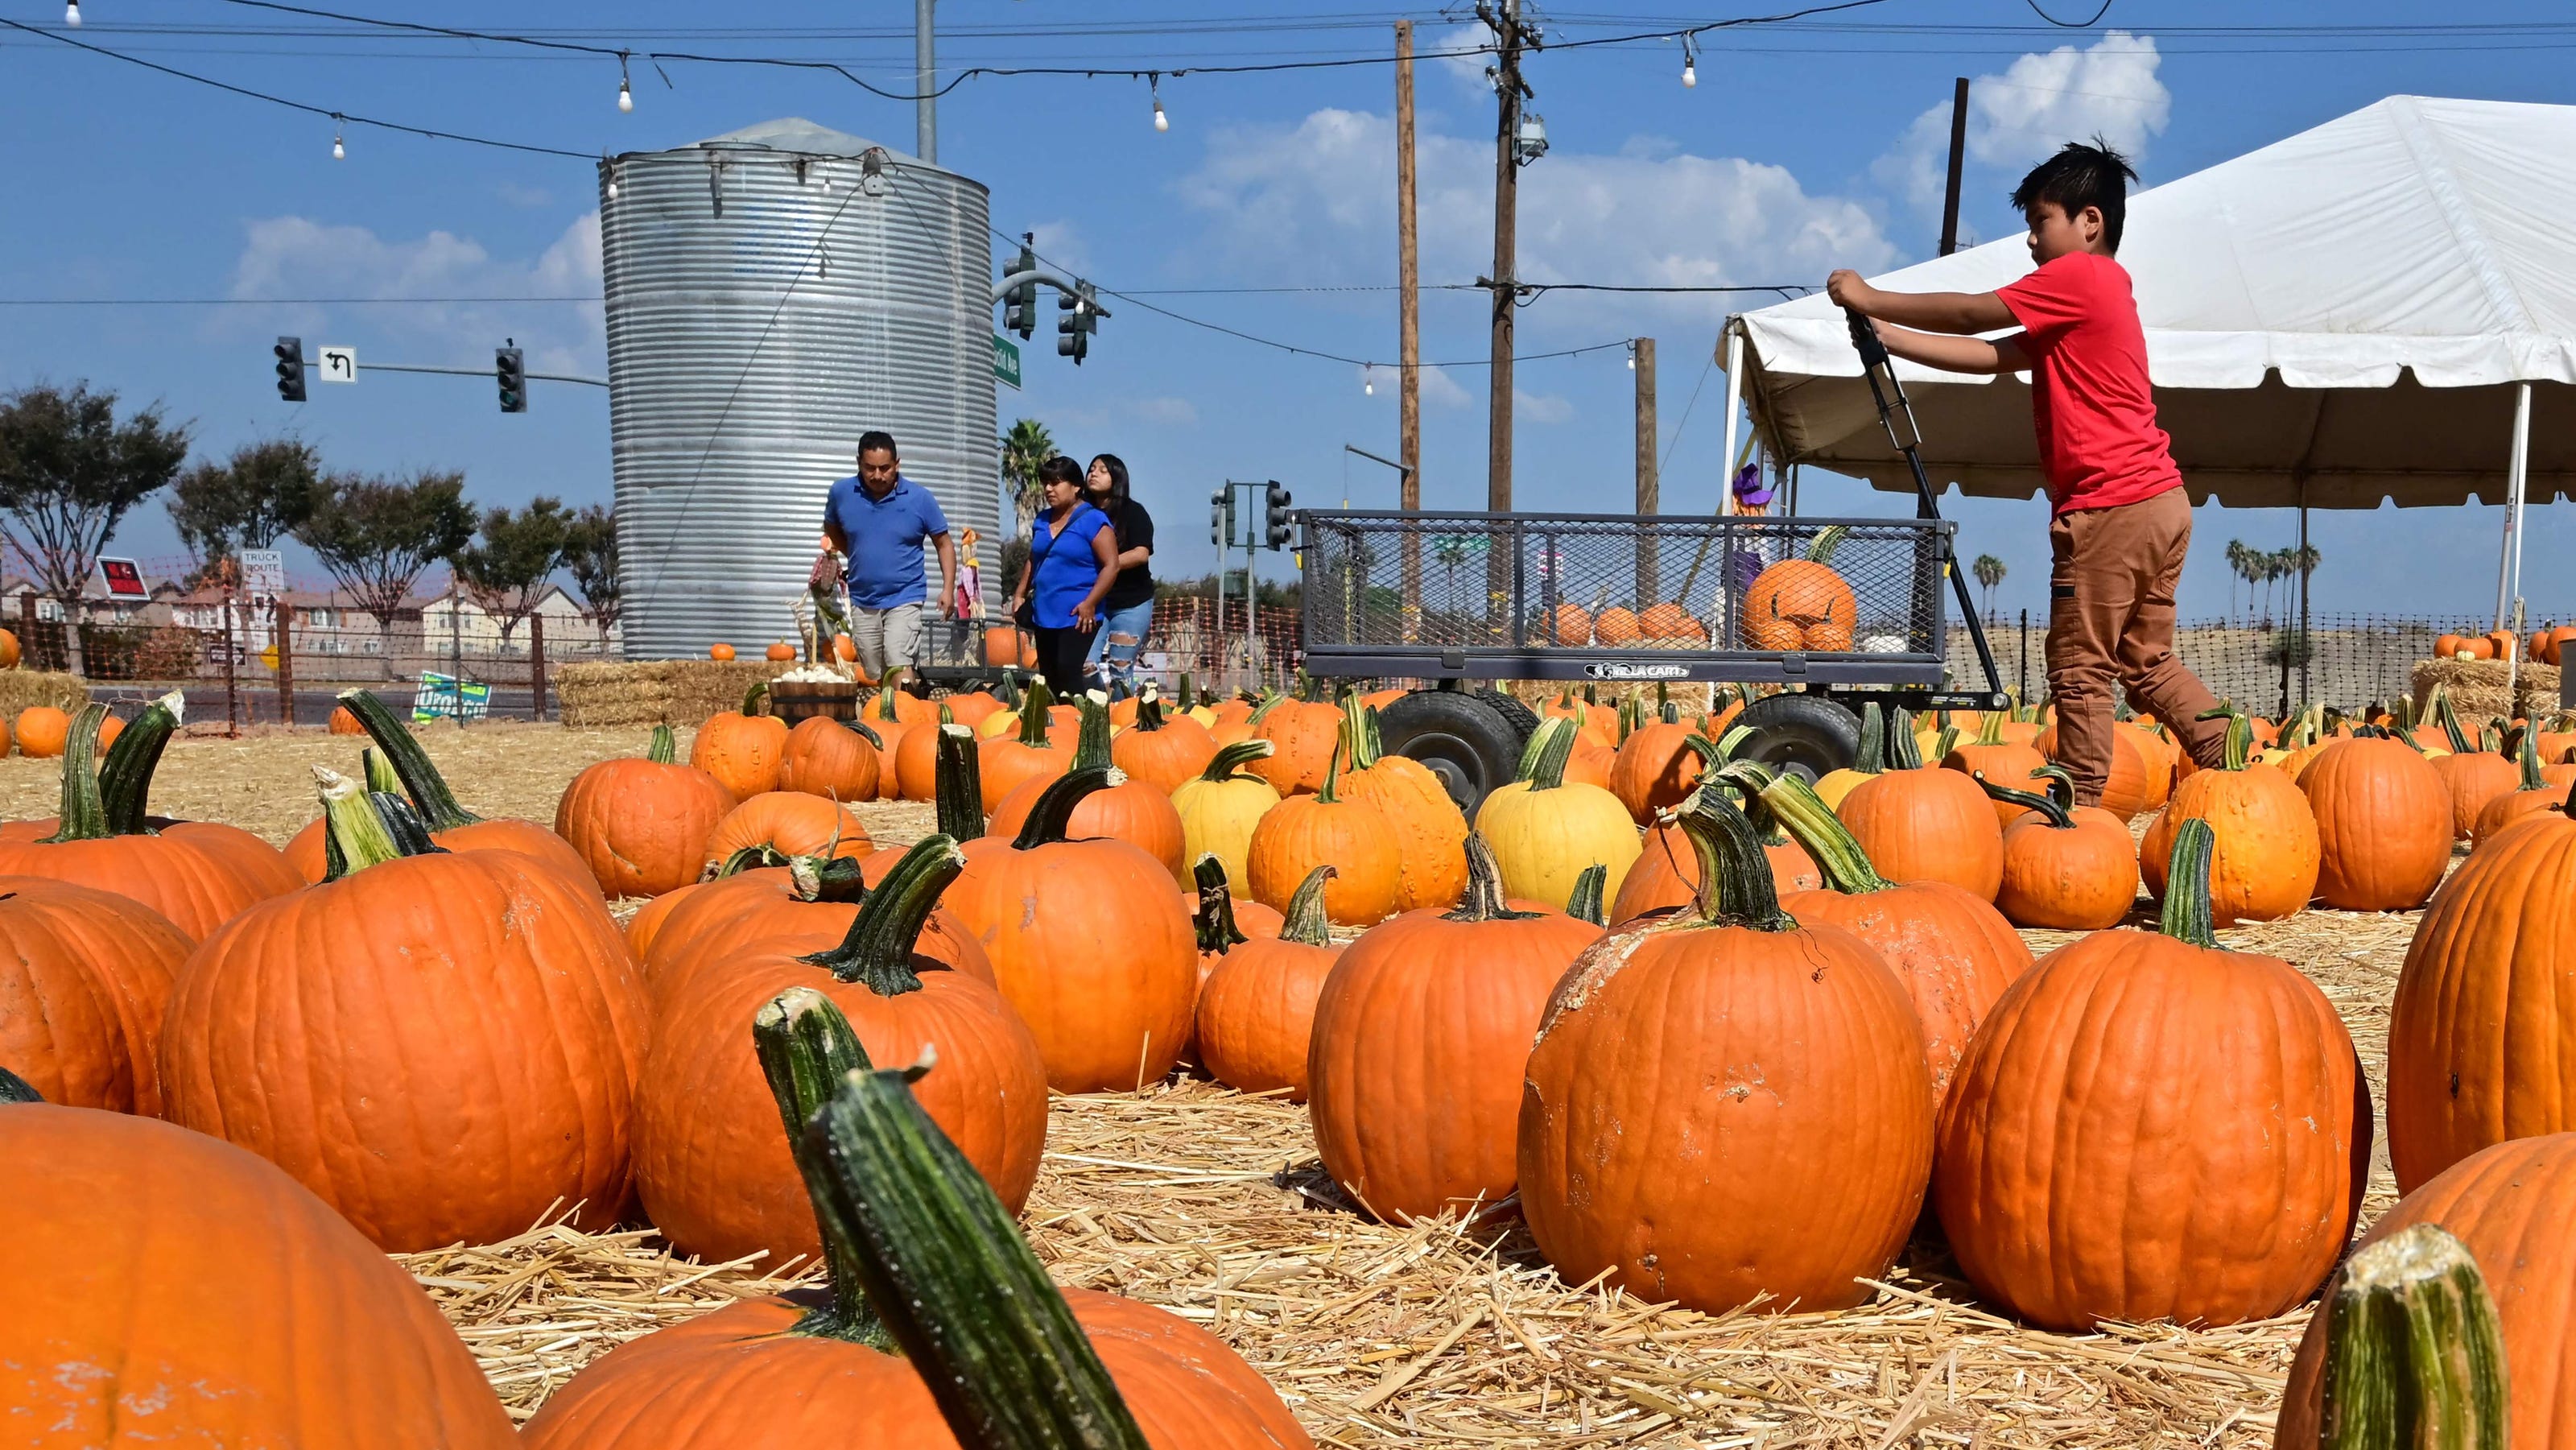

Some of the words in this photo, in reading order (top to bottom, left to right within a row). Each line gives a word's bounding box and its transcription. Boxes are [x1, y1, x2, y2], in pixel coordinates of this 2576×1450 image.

[246, 553, 279, 561] TRUCK
[246, 564, 279, 572] ROUTE
[1647, 666, 1688, 677] CARTS
